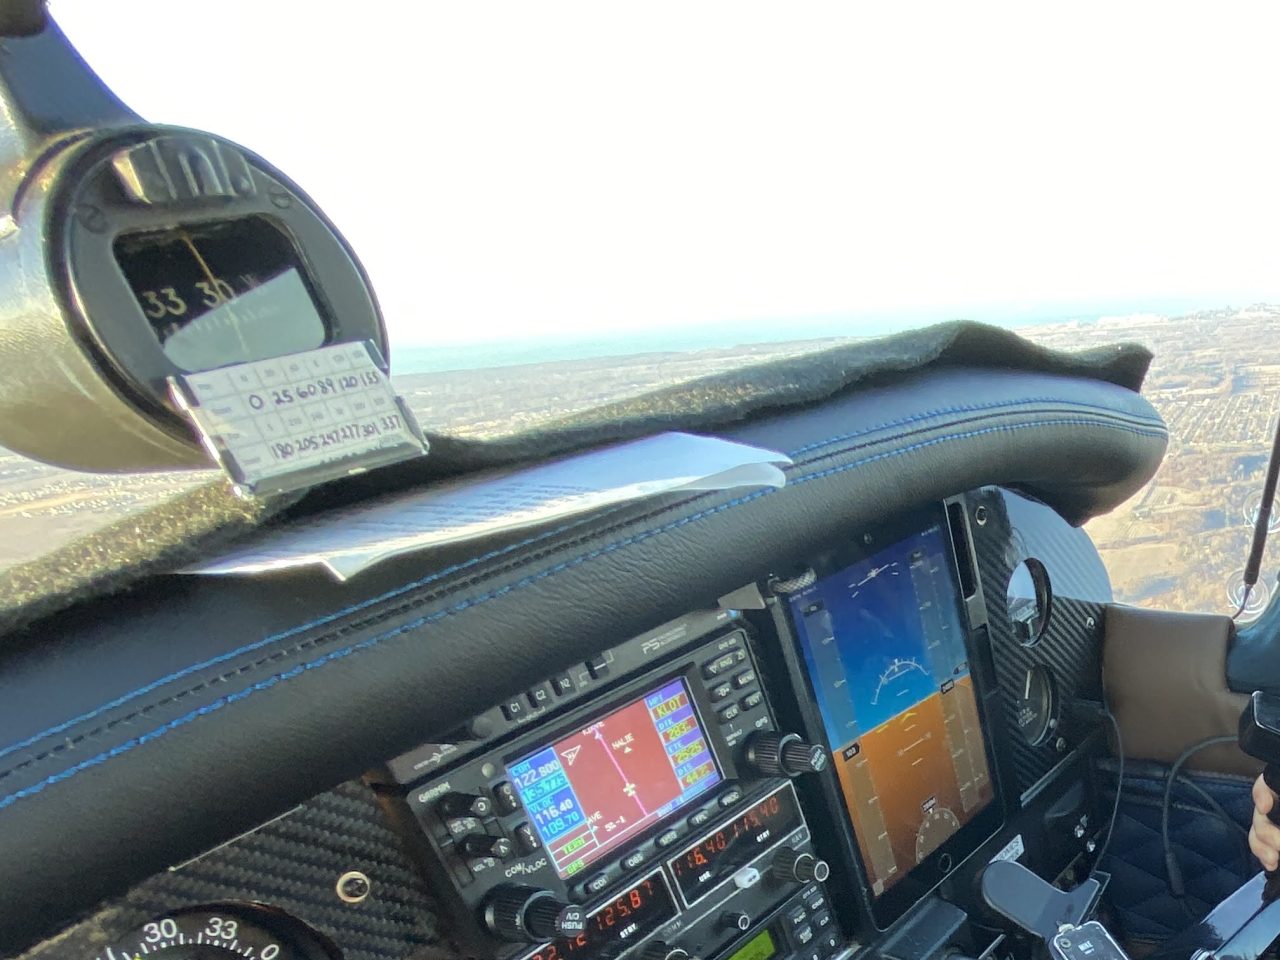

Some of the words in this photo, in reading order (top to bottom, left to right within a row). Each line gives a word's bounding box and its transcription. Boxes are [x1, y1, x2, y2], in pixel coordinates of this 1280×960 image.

[143, 287, 188, 318] 33
[656, 696, 682, 717] KLOT
[418, 782, 451, 803] GARMIN
[535, 798, 574, 825] 116.40
[542, 813, 580, 838] 109.70
[756, 830, 770, 842] STBY
[505, 858, 548, 879] COM/VLOC
[628, 856, 644, 867] OBS
[593, 879, 607, 891] CDI
[698, 871, 712, 882] USE
[144, 919, 177, 943] 30
[205, 917, 238, 940] 33
[561, 922, 583, 930] PUSH
[619, 923, 637, 938] STBY
[260, 944, 280, 960] 0
[829, 939, 836, 948] 9
